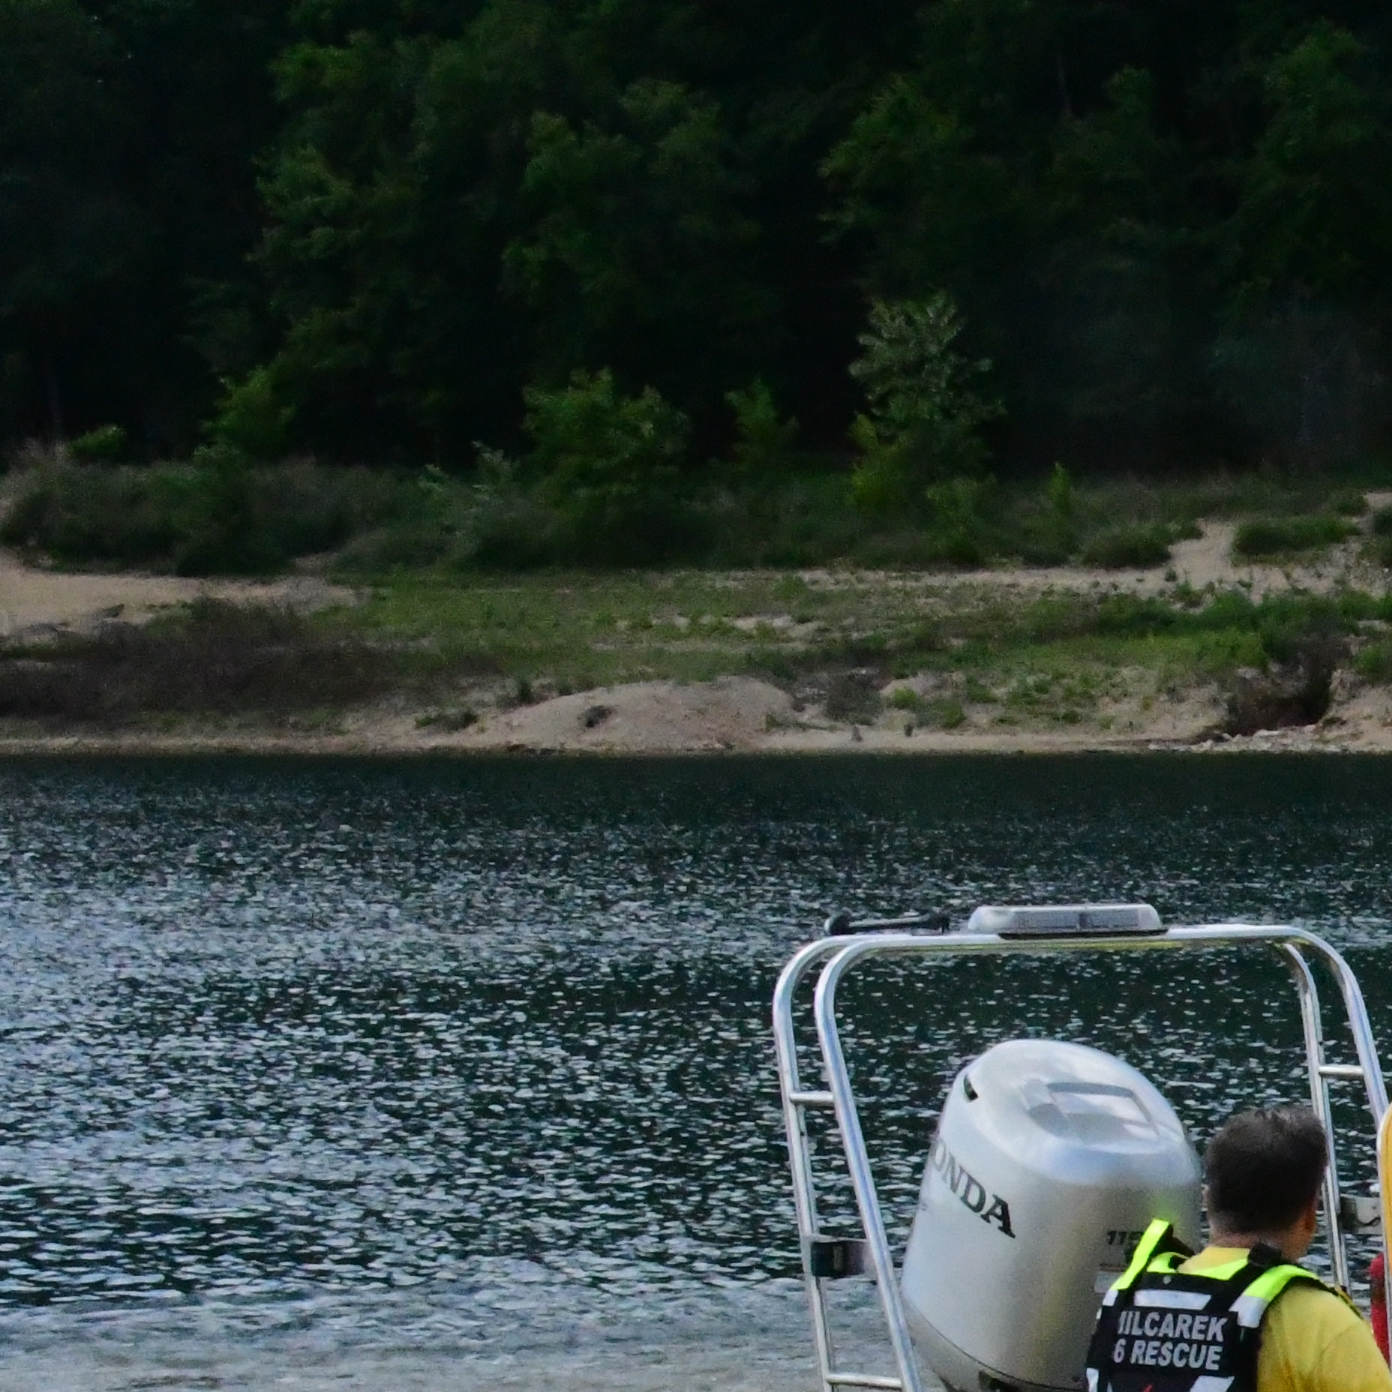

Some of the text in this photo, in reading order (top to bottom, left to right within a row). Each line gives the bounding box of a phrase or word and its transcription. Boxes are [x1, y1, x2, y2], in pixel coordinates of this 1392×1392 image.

[930, 1137, 1017, 1239] ONDA
[1117, 1310, 1229, 1342] ILCAREK
[1130, 1339, 1223, 1370] RESCUE
